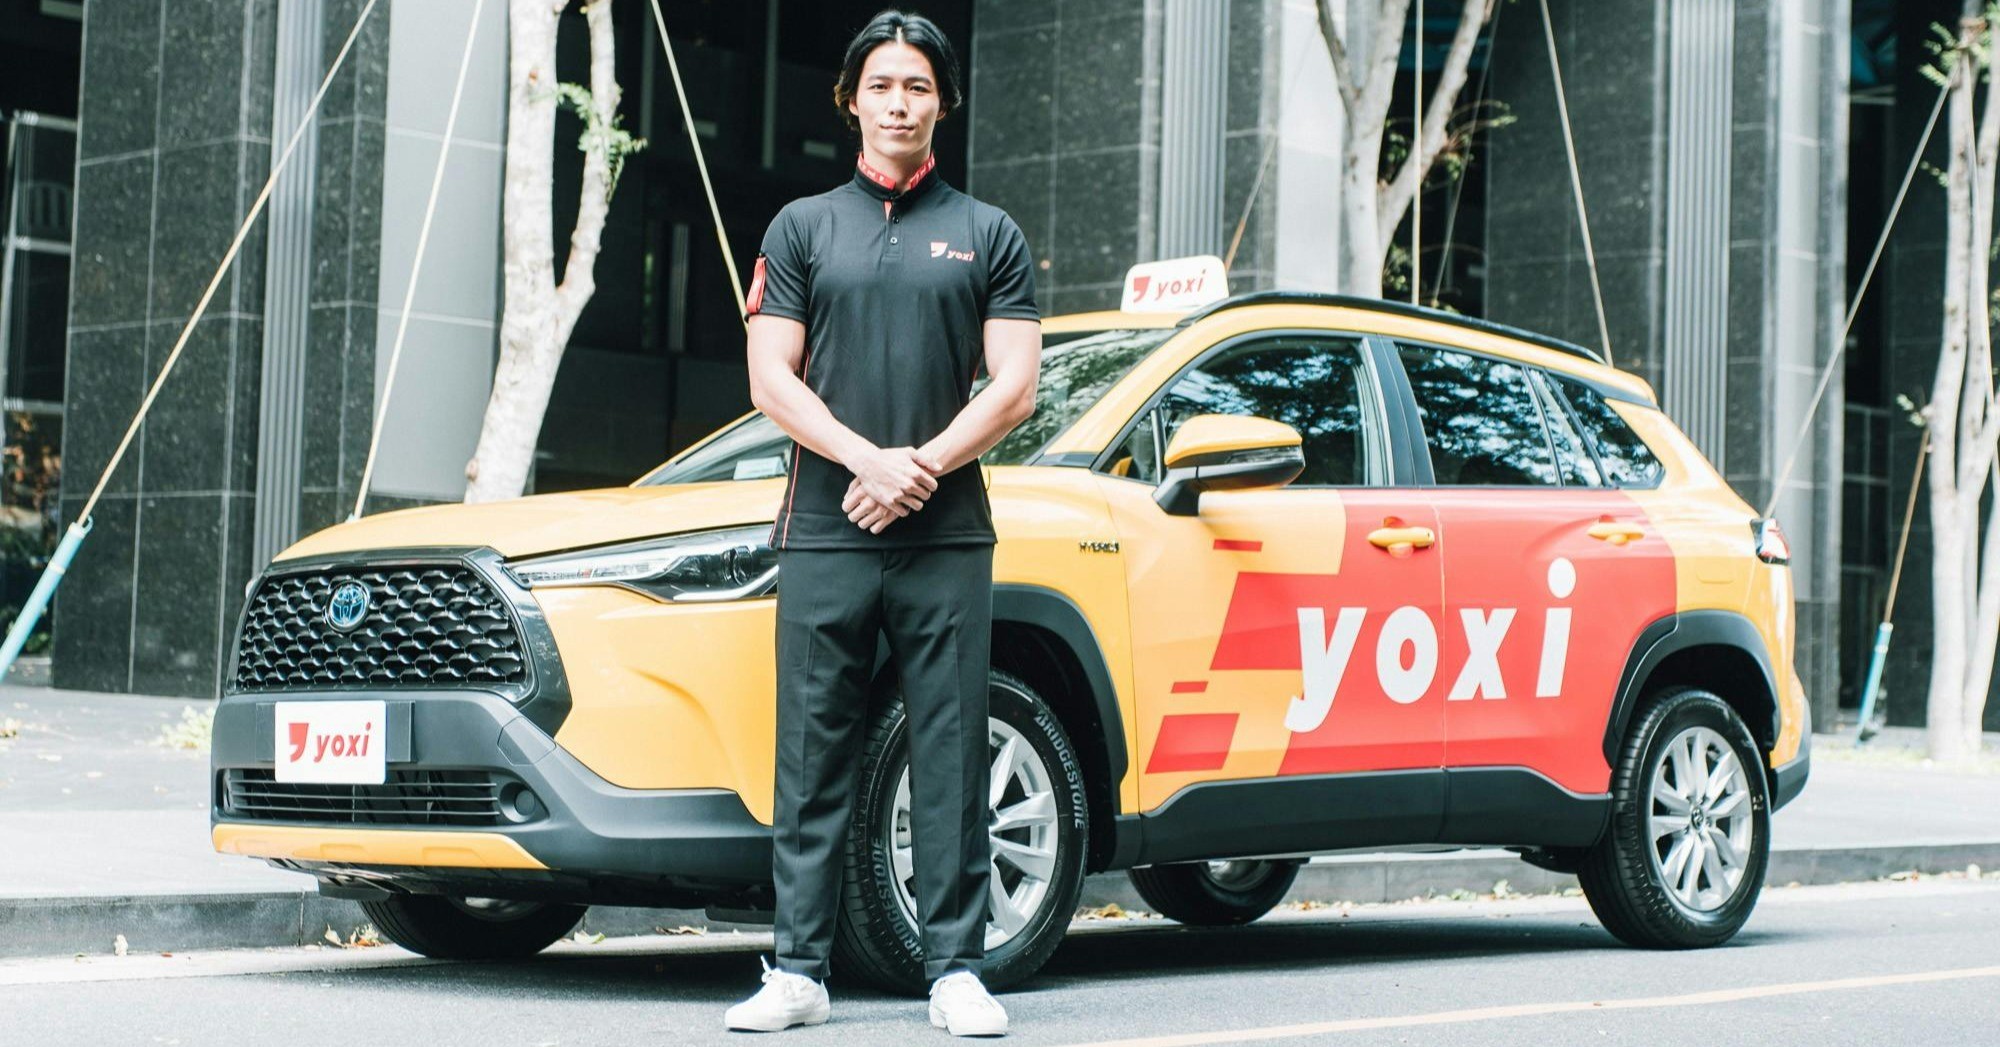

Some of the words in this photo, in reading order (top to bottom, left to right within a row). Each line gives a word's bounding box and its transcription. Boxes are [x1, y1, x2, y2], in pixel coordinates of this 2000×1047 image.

[947, 250, 975, 262] yoxi
[1155, 269, 1206, 300] yoxi
[1284, 557, 1577, 733] yoxi
[314, 722, 371, 763] yoxi
[1034, 711, 1086, 829] BRIDGESTONE
